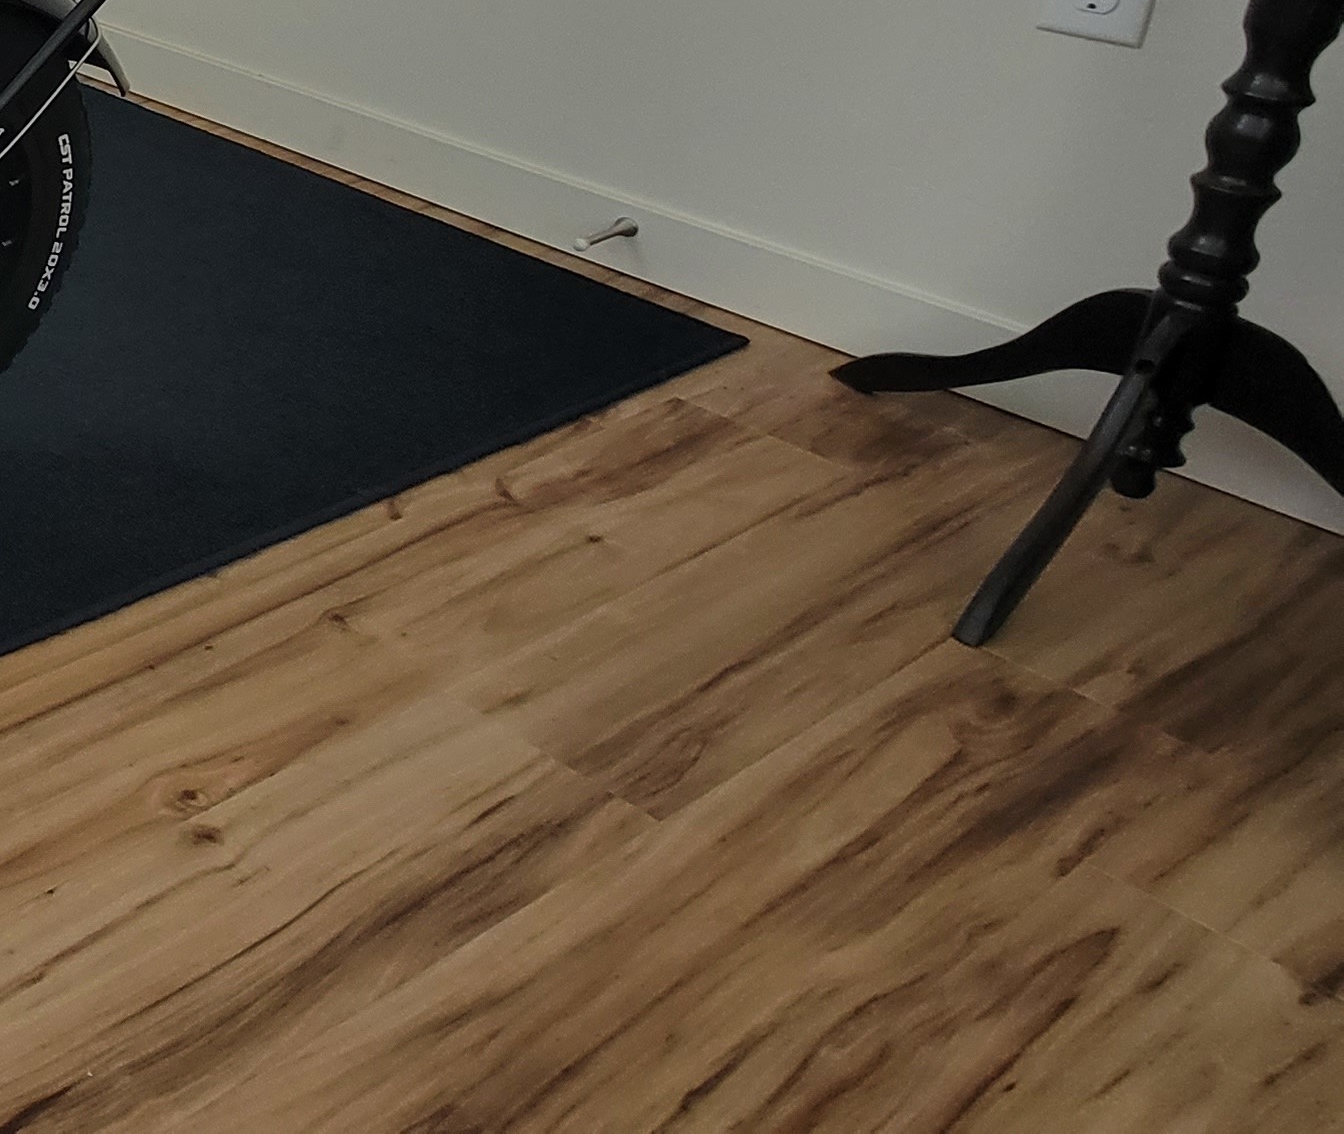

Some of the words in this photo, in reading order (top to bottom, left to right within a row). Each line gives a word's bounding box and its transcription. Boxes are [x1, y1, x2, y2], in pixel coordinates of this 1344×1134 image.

[57, 133, 73, 165] CST
[55, 167, 74, 239] PATROL
[27, 241, 63, 310] 20X3.0
